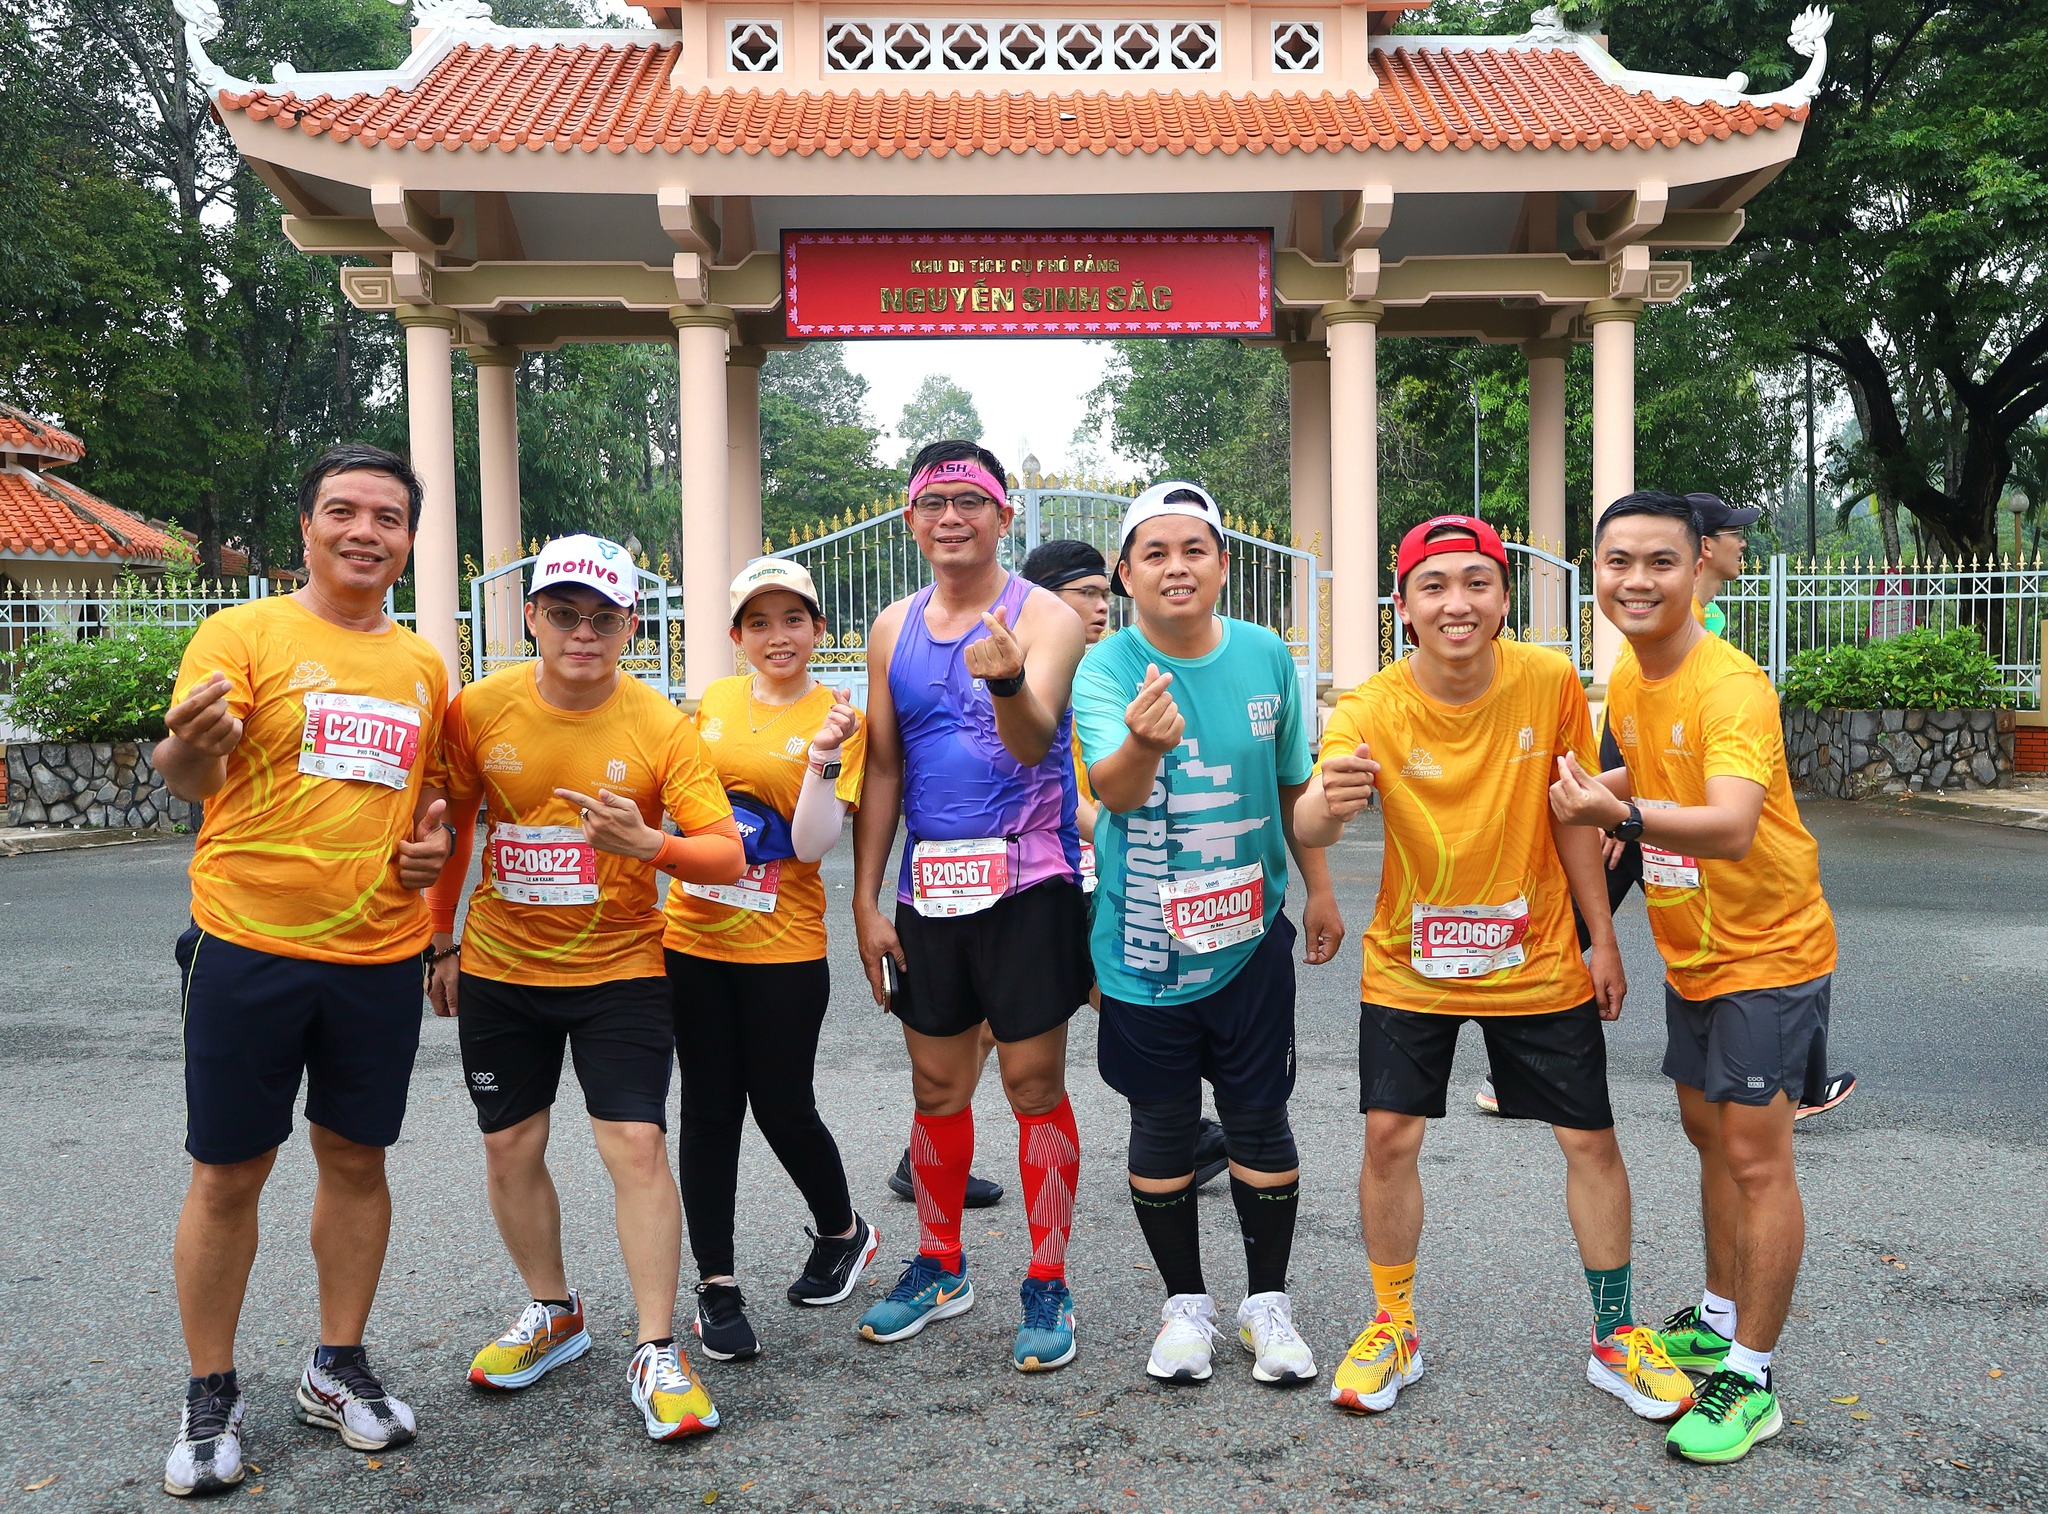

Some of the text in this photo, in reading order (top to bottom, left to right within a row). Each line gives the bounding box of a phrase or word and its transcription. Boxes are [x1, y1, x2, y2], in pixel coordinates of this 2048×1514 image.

[911, 259, 944, 273] KHU
[948, 259, 965, 273] DI
[968, 256, 1007, 273] TÍCH
[1011, 259, 1033, 277] CỤ
[1074, 254, 1120, 273] BẢNG
[879, 277, 1015, 313] NGUYỄN
[1022, 286, 1100, 313] SINH
[545, 558, 619, 585] motive
[1247, 700, 1272, 721] CEO
[305, 709, 320, 740] 21KM
[323, 713, 408, 753] C20717
[304, 744, 313, 752] M
[500, 845, 582, 873] C20822
[921, 860, 992, 886] B20567
[1123, 817, 1171, 975] RUNNER
[1176, 888, 1253, 927] B20400
[1163, 903, 1175, 930] 21KM
[1412, 921, 1423, 947] 21KM
[1428, 921, 1515, 947] C20666
[1413, 949, 1421, 957] M
[472, 1084, 499, 1092] OLYMPIC
